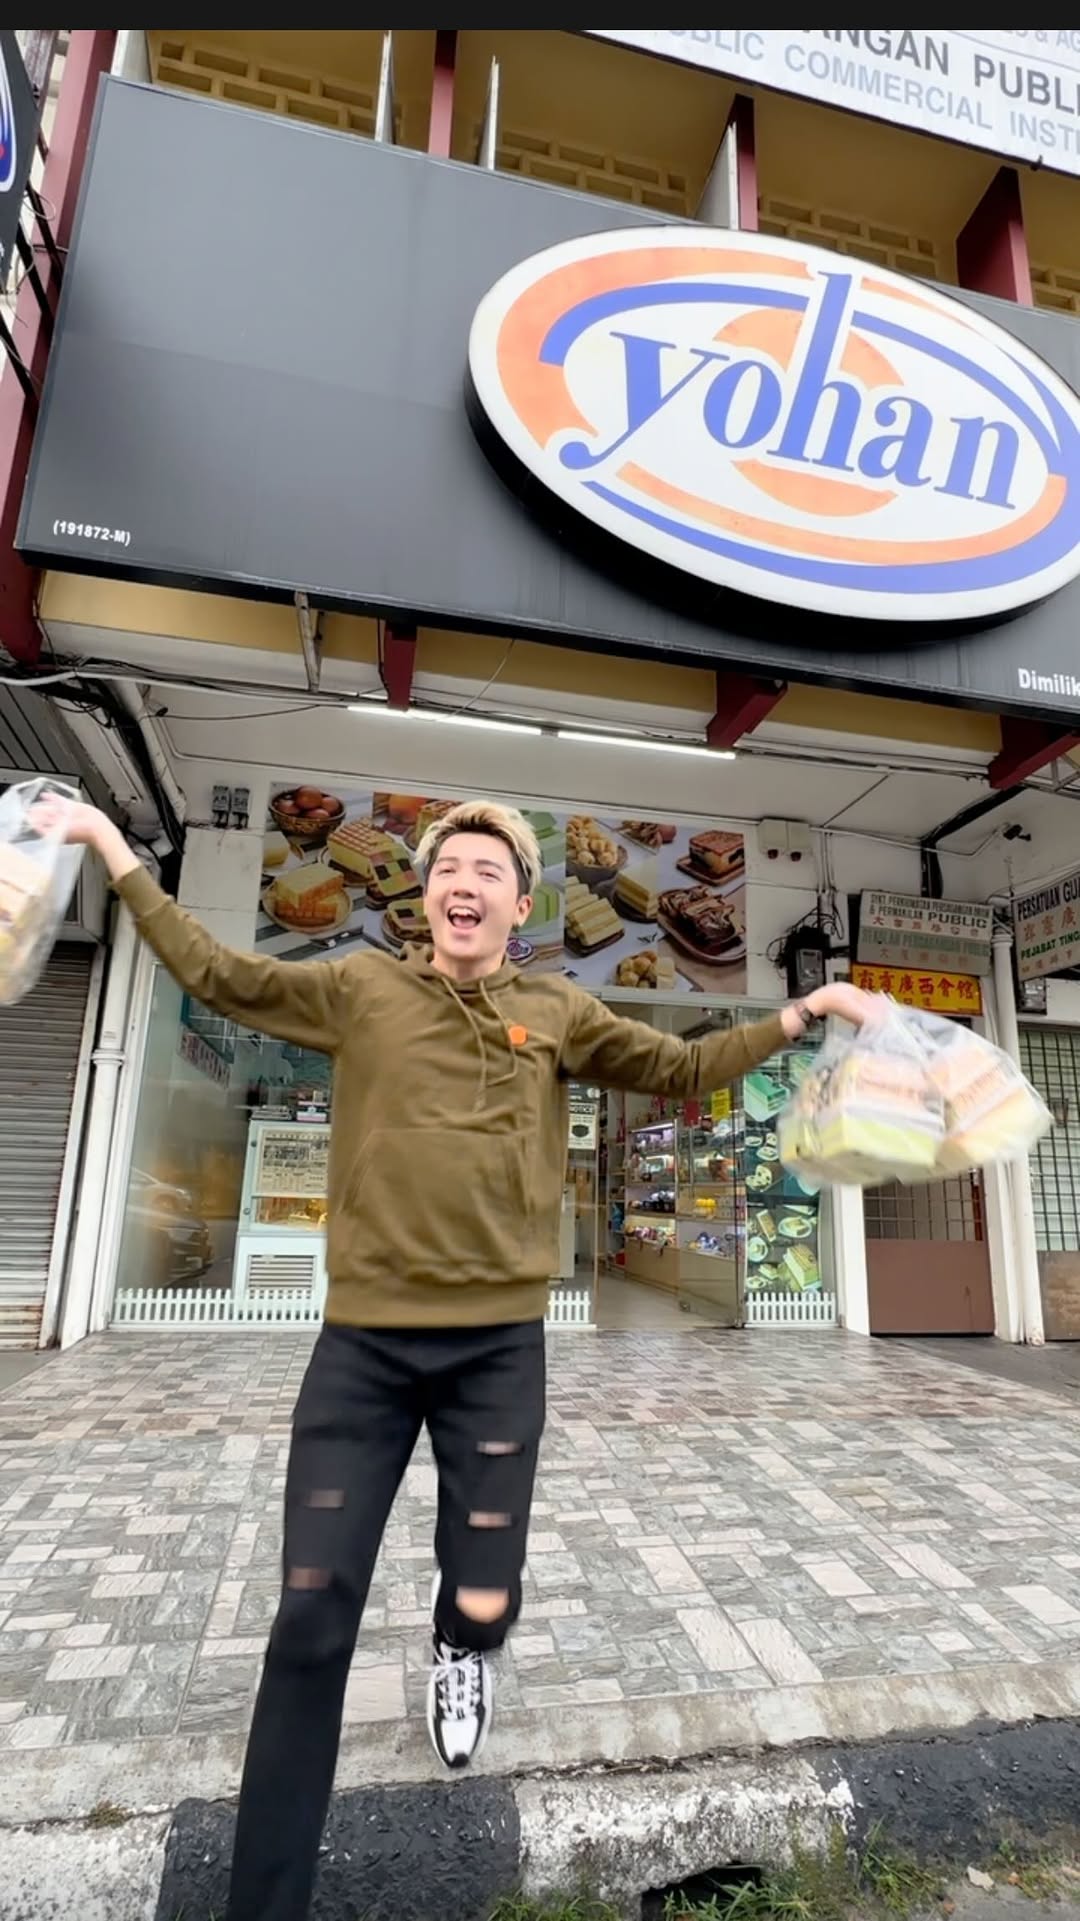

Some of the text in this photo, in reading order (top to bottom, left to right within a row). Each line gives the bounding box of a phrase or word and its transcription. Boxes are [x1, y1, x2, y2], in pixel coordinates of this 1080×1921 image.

[803, 31, 948, 76] GAN
[668, 31, 764, 60] LIC
[785, 44, 992, 130] COMMERCIAL
[559, 271, 1016, 511] yohan
[53, 520, 131, 547] (191872-M)
[1063, 876, 1080, 903] GU
[928, 911, 987, 928] PUBLIC
